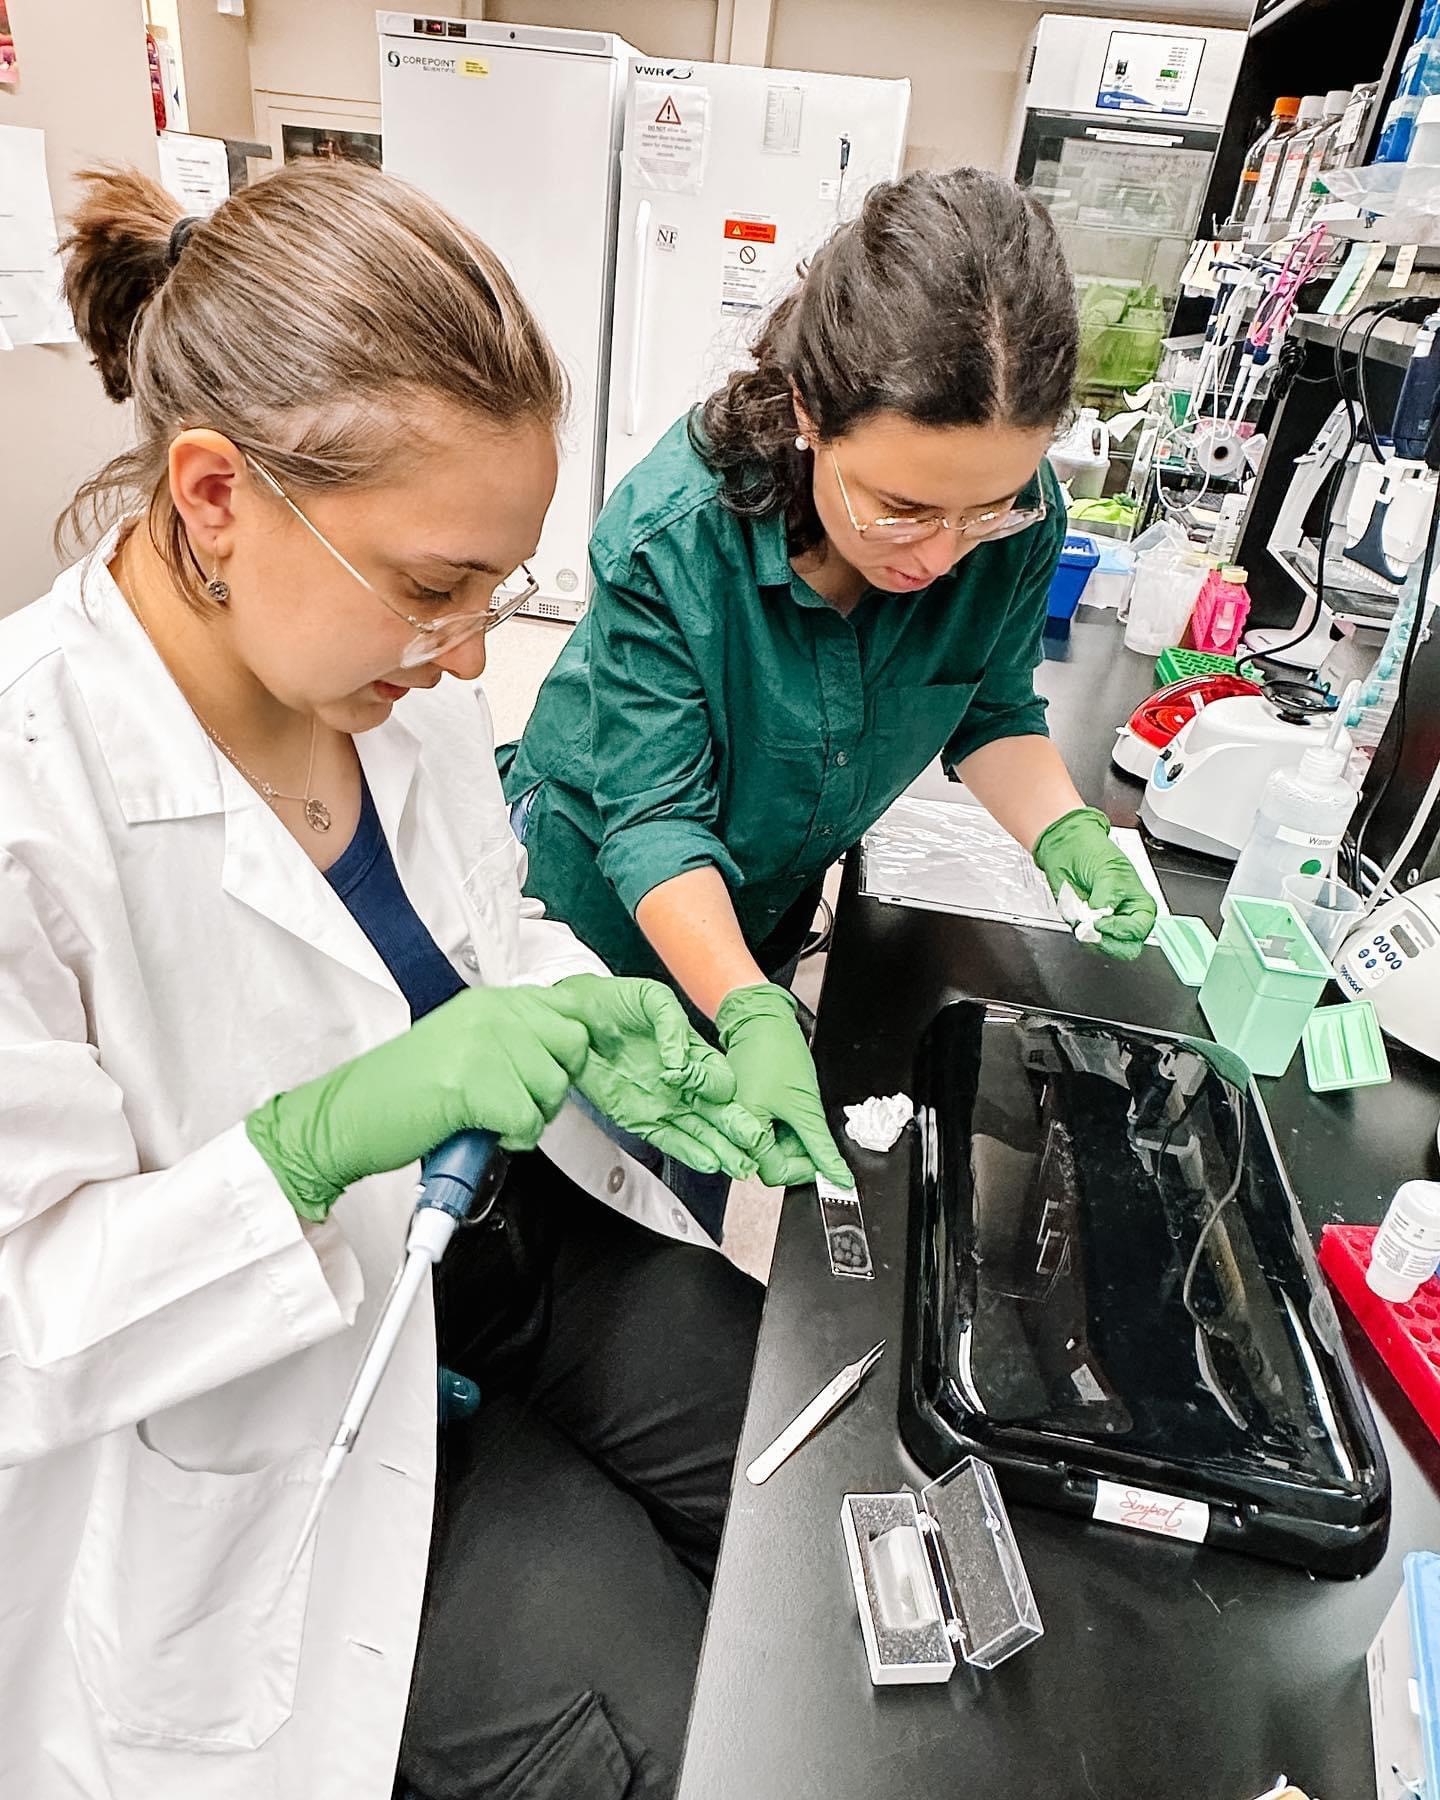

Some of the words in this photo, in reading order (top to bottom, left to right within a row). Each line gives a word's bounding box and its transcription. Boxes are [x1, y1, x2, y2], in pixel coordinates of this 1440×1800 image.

[402, 55, 456, 68] COREPOINT
[635, 65, 665, 77] VWR
[657, 229, 678, 244] NF
[1309, 836, 1333, 846] Water
